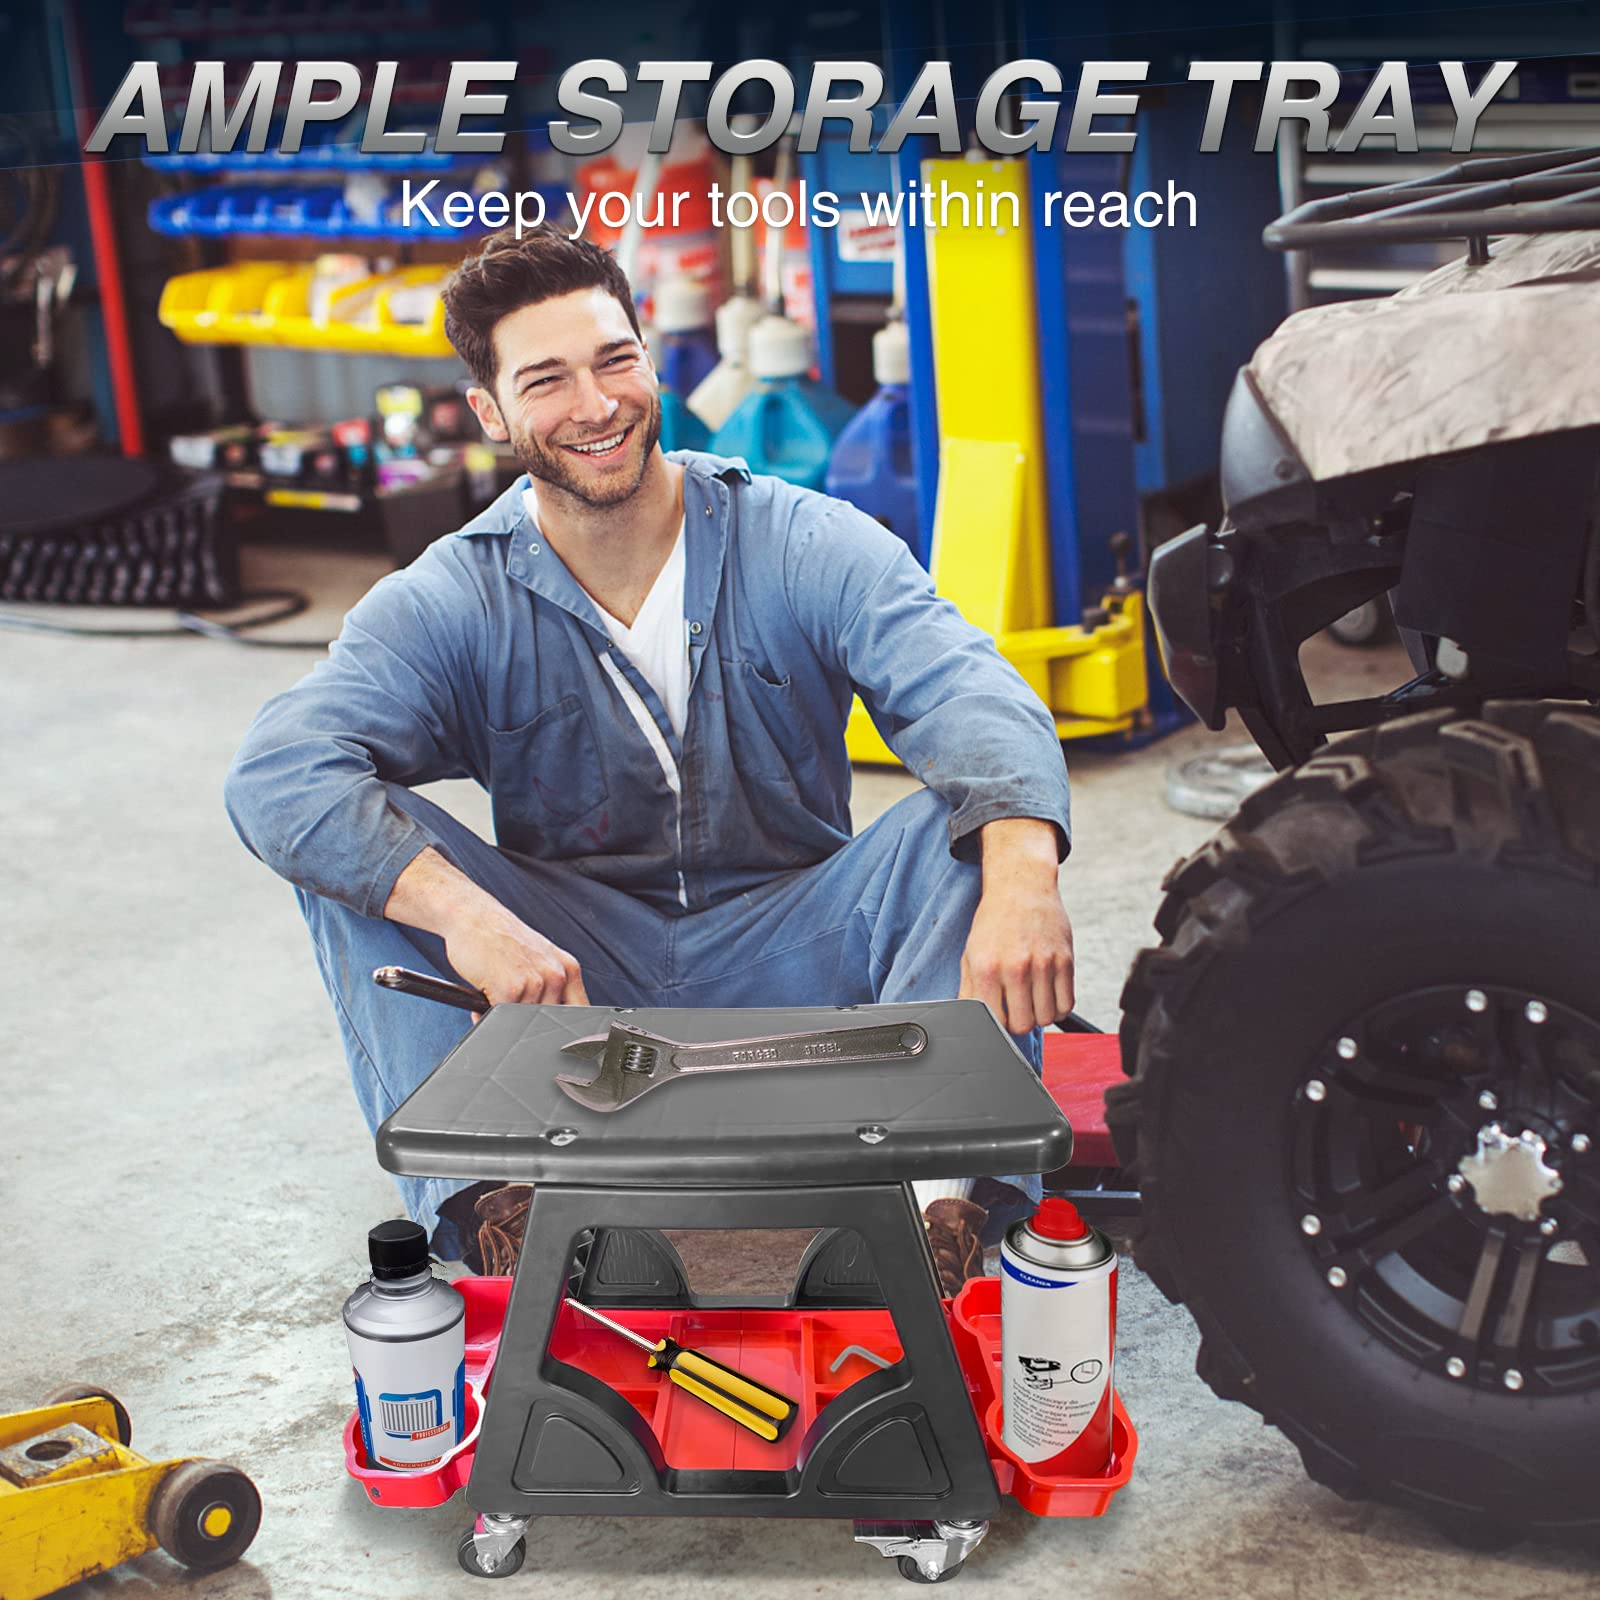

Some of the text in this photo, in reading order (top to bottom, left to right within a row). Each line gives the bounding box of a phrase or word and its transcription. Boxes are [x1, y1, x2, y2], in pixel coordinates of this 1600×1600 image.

[732, 1042, 843, 1062] FORGED STEEL
[415, 1423, 449, 1439] PROFESSIONAL
